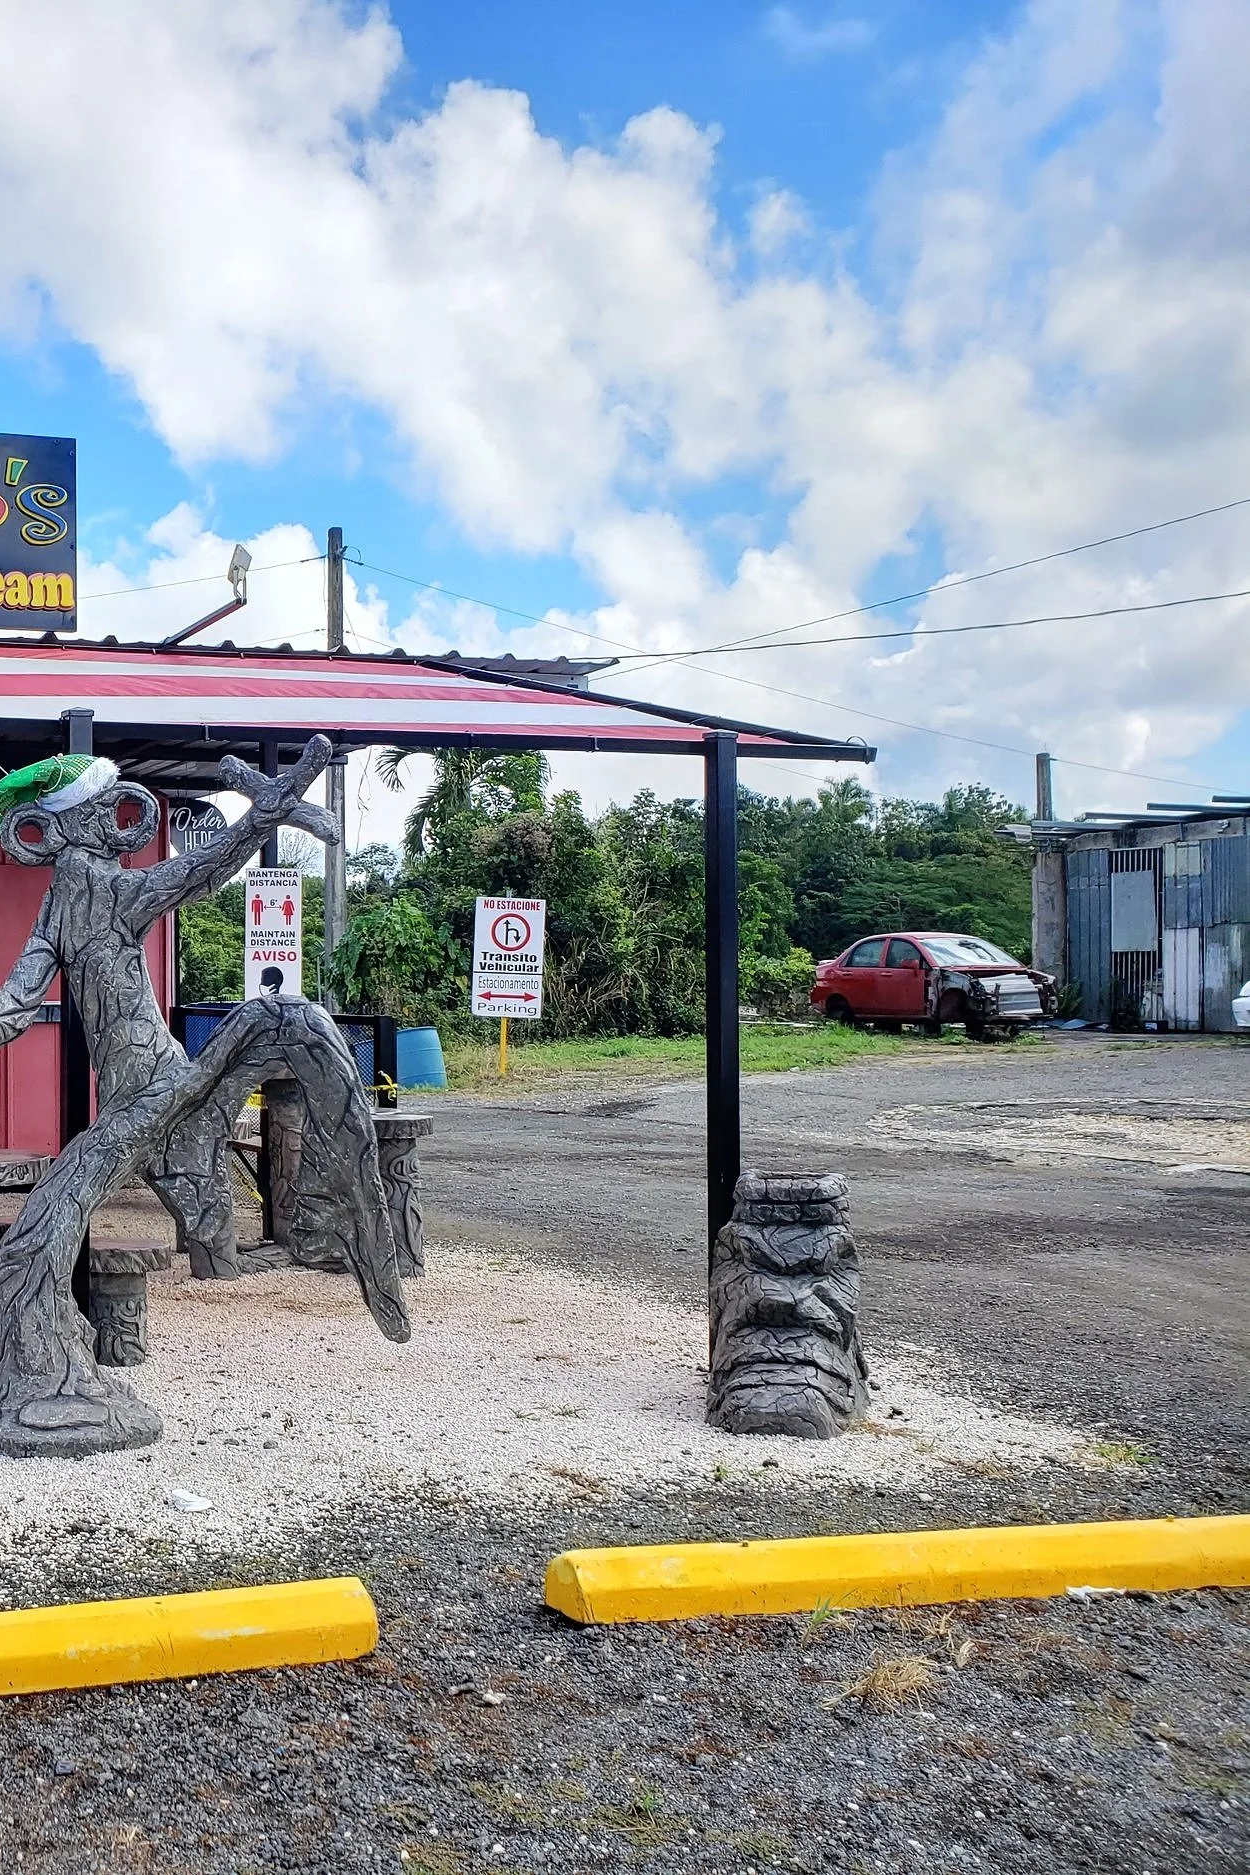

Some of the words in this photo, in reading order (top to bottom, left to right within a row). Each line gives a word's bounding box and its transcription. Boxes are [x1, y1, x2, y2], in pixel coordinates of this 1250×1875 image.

[174, 807, 225, 831] Order
[248, 870, 299, 878] MANTENGA
[249, 879, 298, 887] DISTANCIA
[483, 899, 495, 910] NO
[497, 901, 541, 911] ESTACIONE
[250, 930, 296, 938] MAINTAIN
[250, 939, 296, 947] DISTANCE
[252, 951, 297, 961] AVISO
[481, 951, 537, 963] Transito
[479, 962, 539, 973] Vehicular
[477, 1002, 537, 1016] Parking
